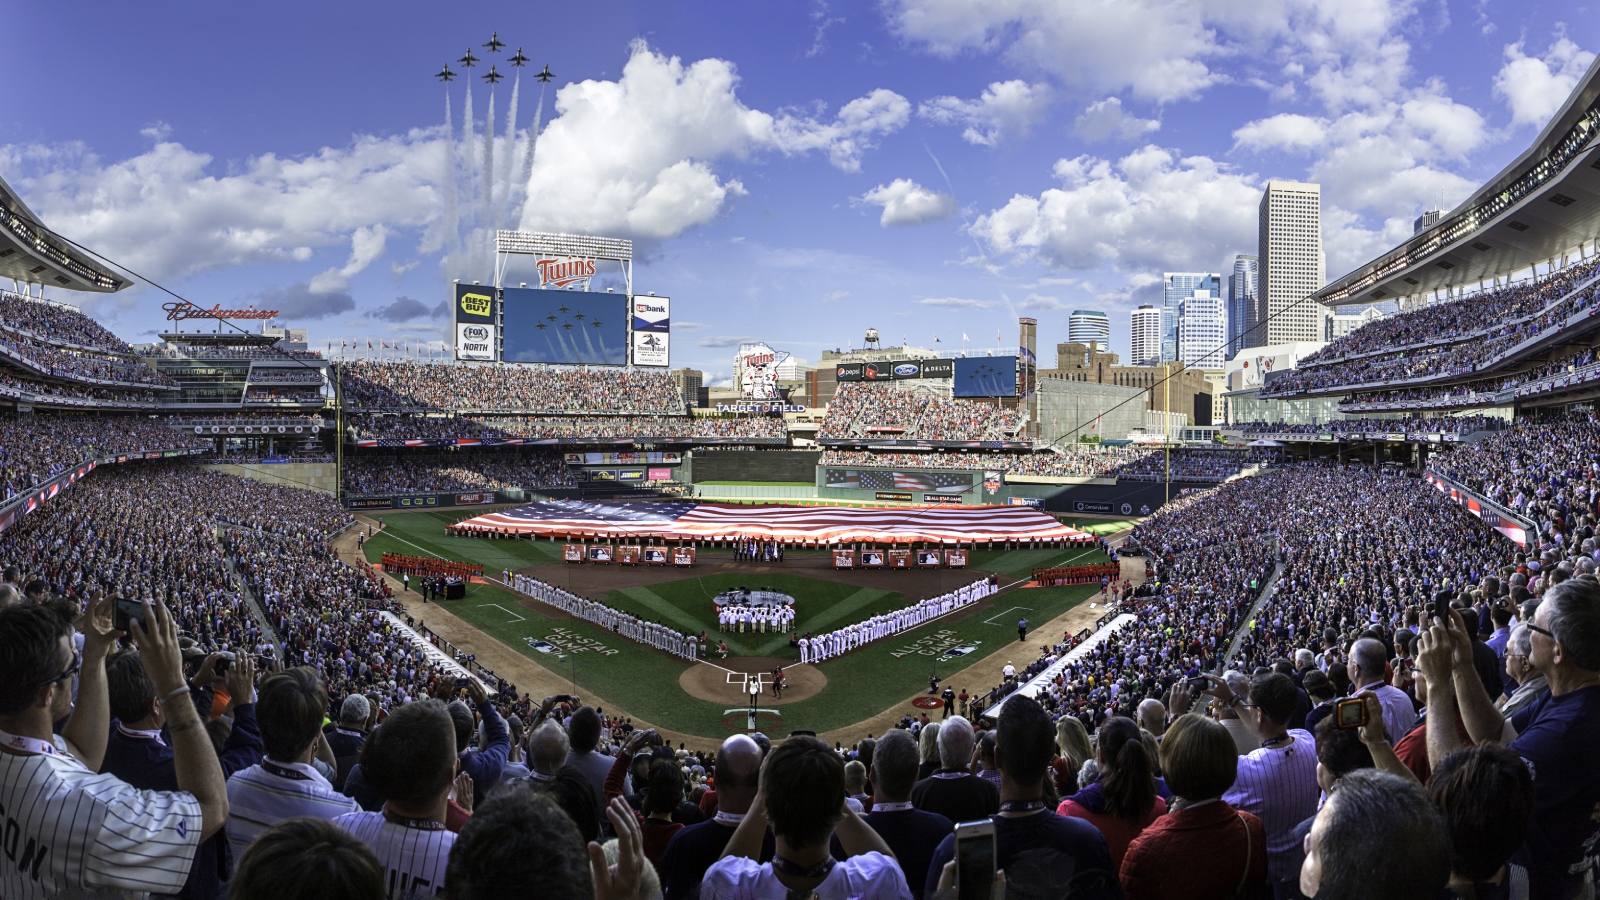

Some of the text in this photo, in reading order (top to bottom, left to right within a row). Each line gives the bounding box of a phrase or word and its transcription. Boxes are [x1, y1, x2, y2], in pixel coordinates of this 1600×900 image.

[536, 255, 596, 284] Twins
[465, 296, 490, 306] BEST
[466, 304, 488, 312] BUY
[162, 302, 279, 320] Budweiser
[469, 328, 483, 336] FOX
[463, 342, 488, 351] NORTH
[744, 352, 774, 367] Twins
[846, 368, 860, 376] pepsi
[545, 635, 589, 653] GAME
[550, 628, 619, 656] ALL STAR
[890, 629, 958, 658] ALL STAR
[918, 637, 964, 656] GAME
